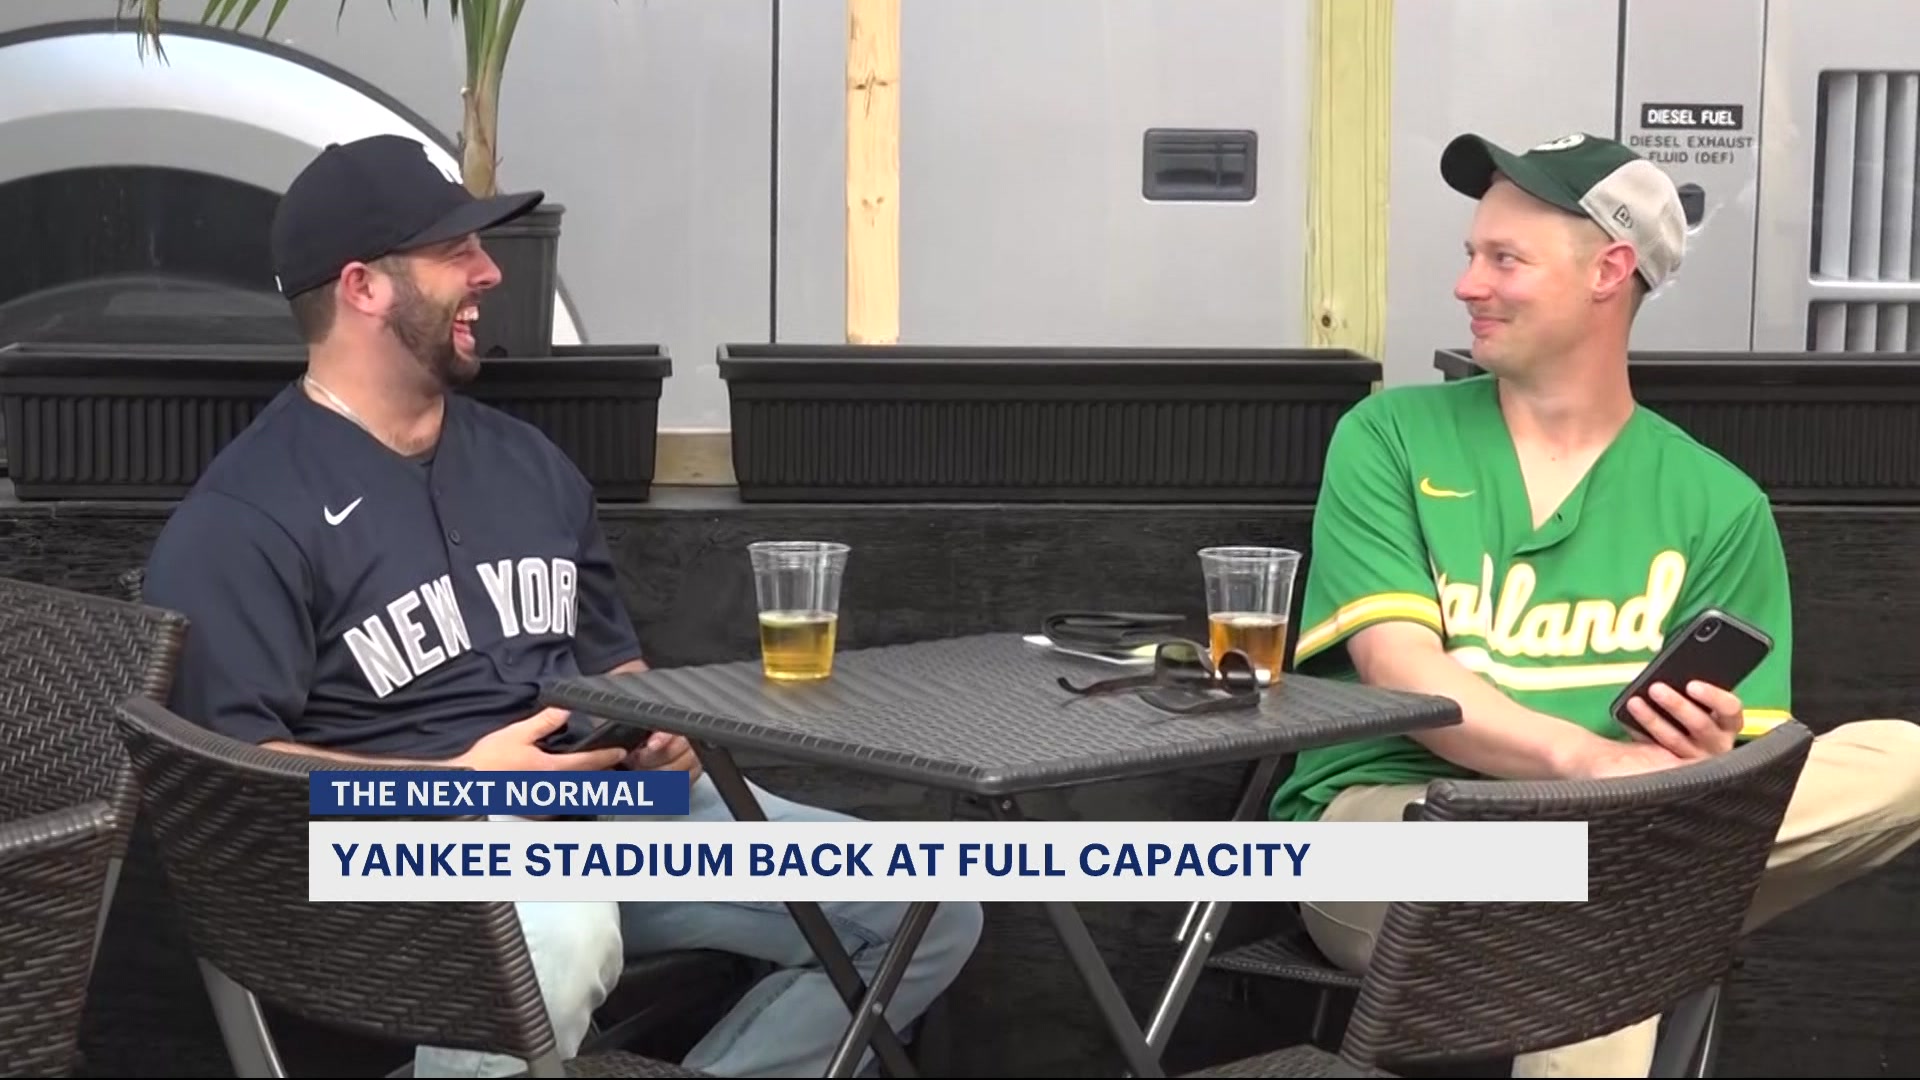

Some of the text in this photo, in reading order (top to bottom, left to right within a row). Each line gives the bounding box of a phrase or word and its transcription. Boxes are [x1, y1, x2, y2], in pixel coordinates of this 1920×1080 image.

[1647, 109, 1736, 126] DIESEL FUEL
[1630, 135, 1753, 149] DIESEL EXHAUST
[1650, 151, 1735, 164] FLUID (DEF)
[342, 557, 578, 699] NEW YOR
